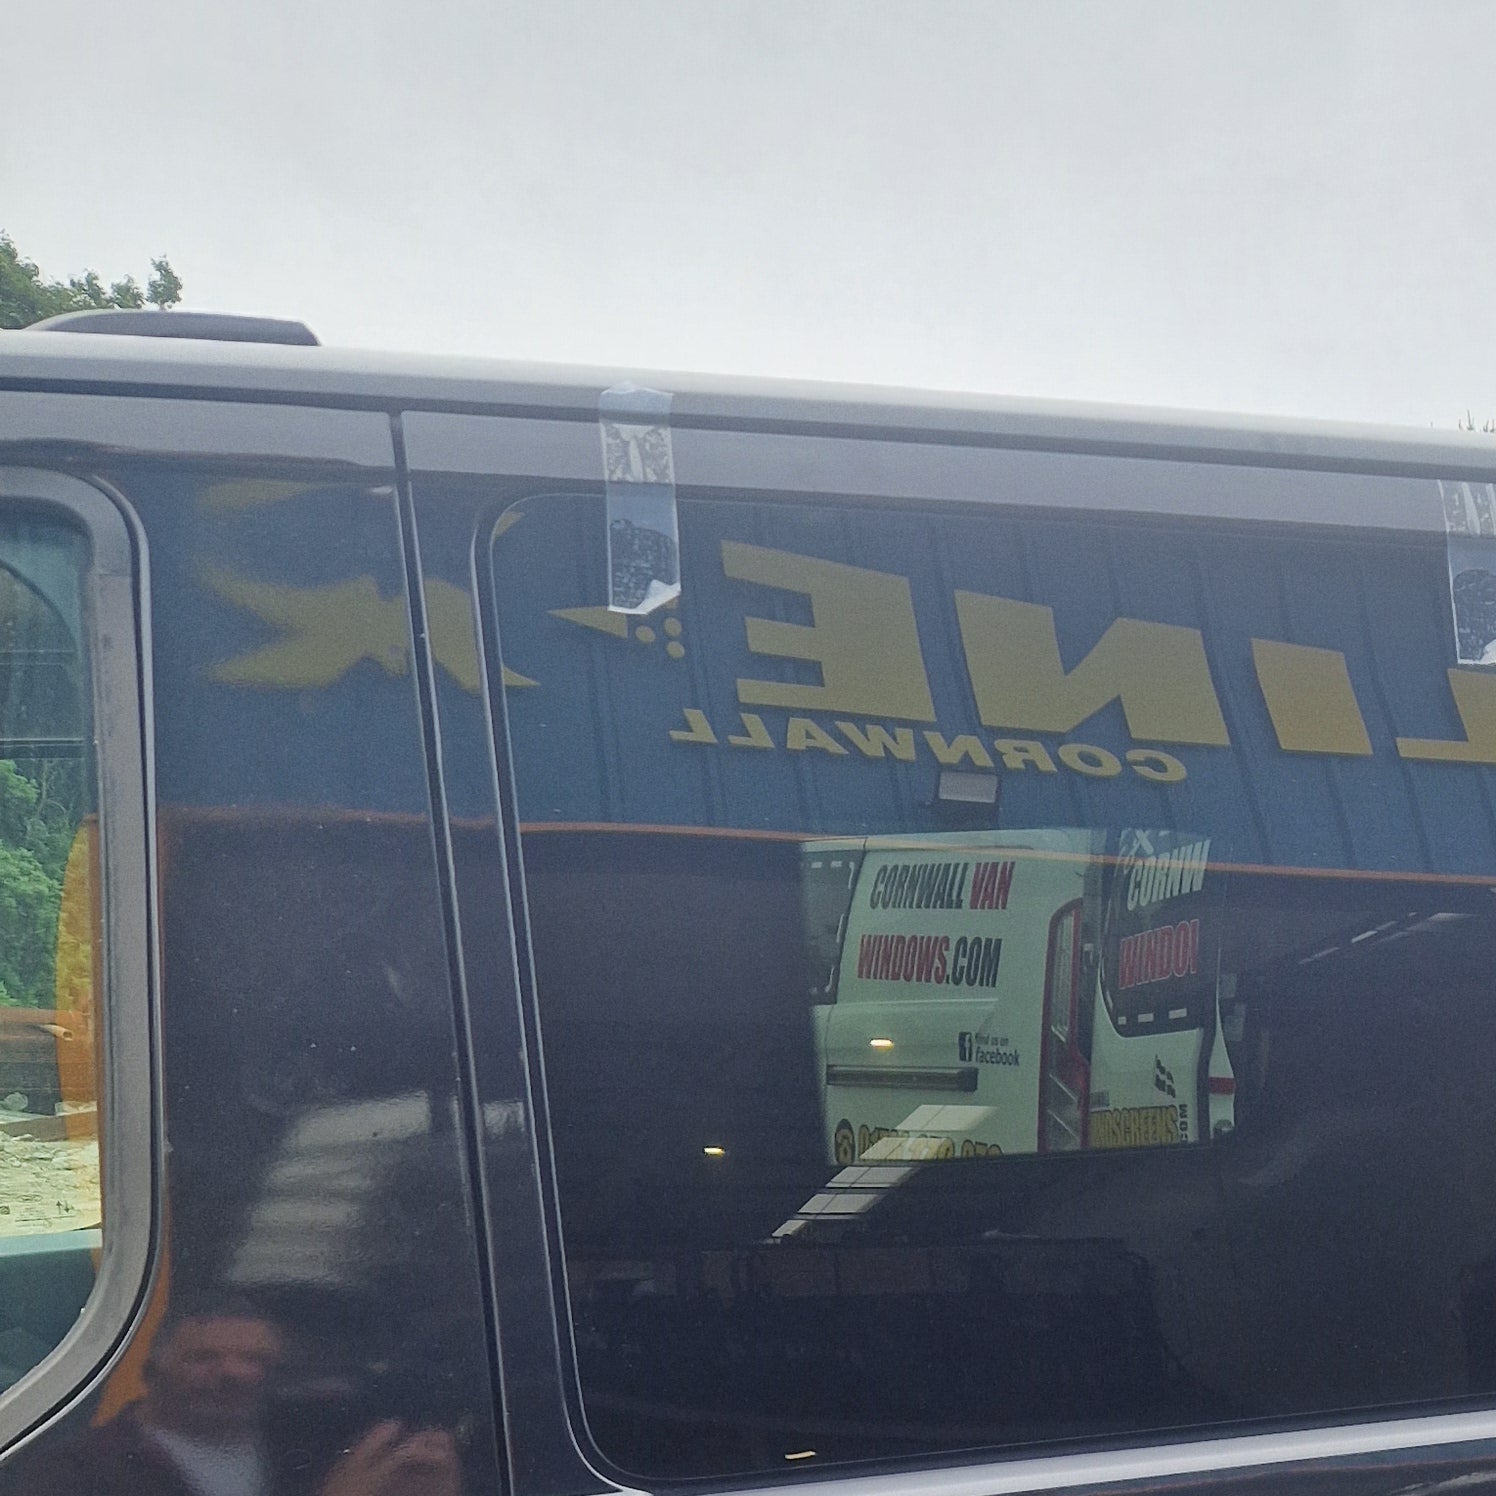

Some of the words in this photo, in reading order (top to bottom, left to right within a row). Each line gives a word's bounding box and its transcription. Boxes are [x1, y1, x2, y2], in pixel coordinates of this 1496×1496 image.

[870, 862, 969, 910] CORNWALL
[969, 861, 1016, 910] VAN
[857, 934, 1003, 988] WINDOWS.COM
[975, 1046, 1020, 1066] facebook
